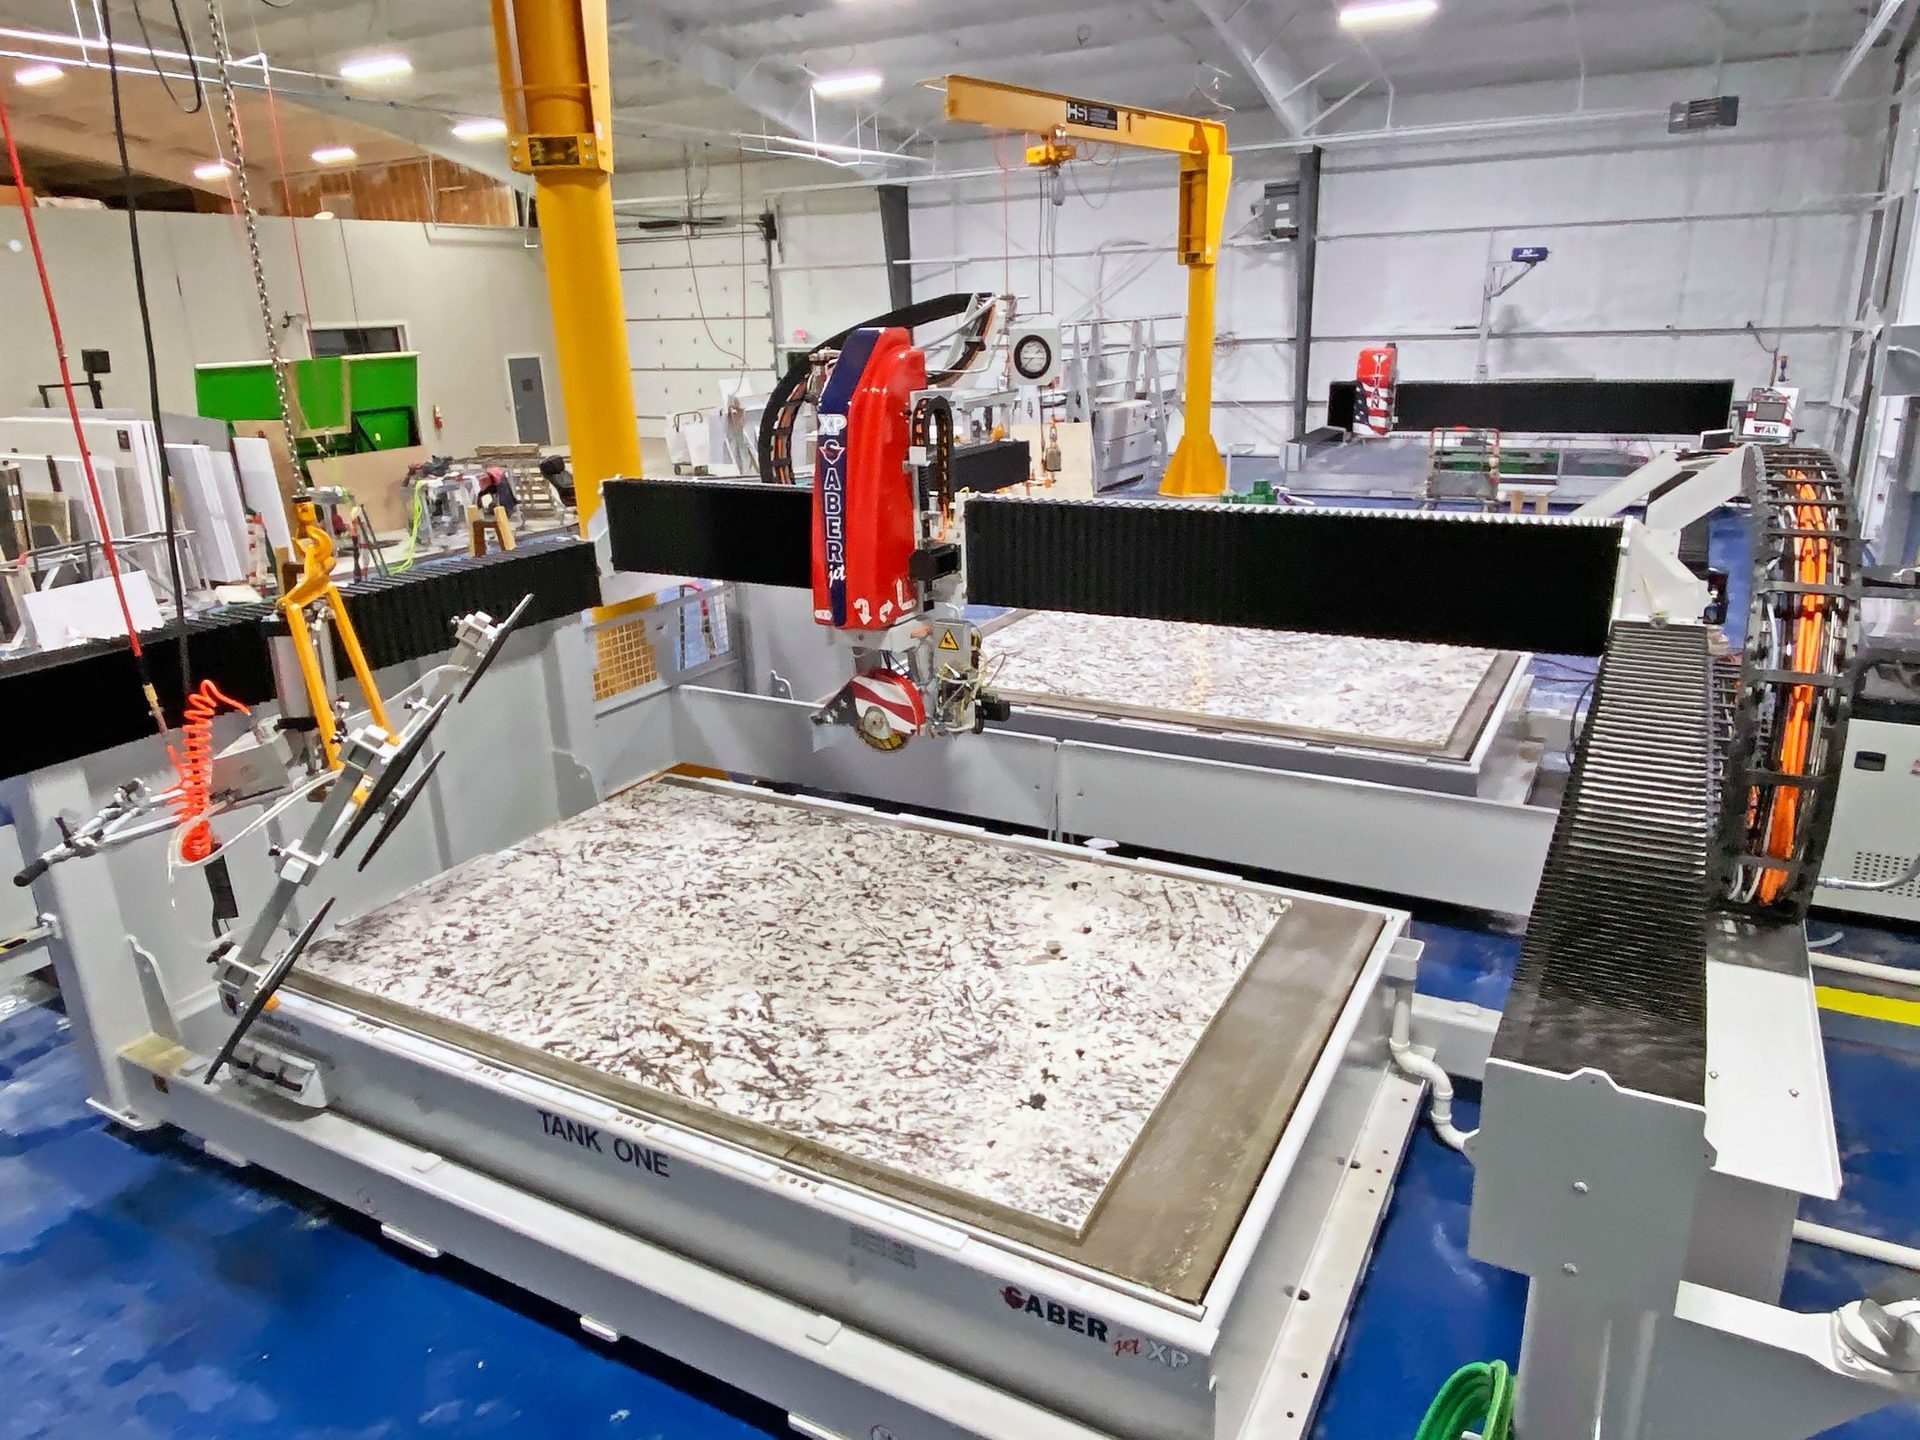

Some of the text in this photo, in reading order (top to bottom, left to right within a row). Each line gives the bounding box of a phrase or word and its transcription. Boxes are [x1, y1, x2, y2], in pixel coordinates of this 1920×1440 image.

[1067, 102, 1088, 121] HSI
[1371, 354, 1386, 408] TITAN
[817, 413, 847, 435] XP
[1754, 426, 1778, 434] TTAN
[819, 439, 846, 563] SABER
[828, 564, 846, 588] jet
[536, 1109, 671, 1178] TANK ONE
[1000, 1286, 1109, 1342] SABER
[1147, 1339, 1190, 1368] XP
